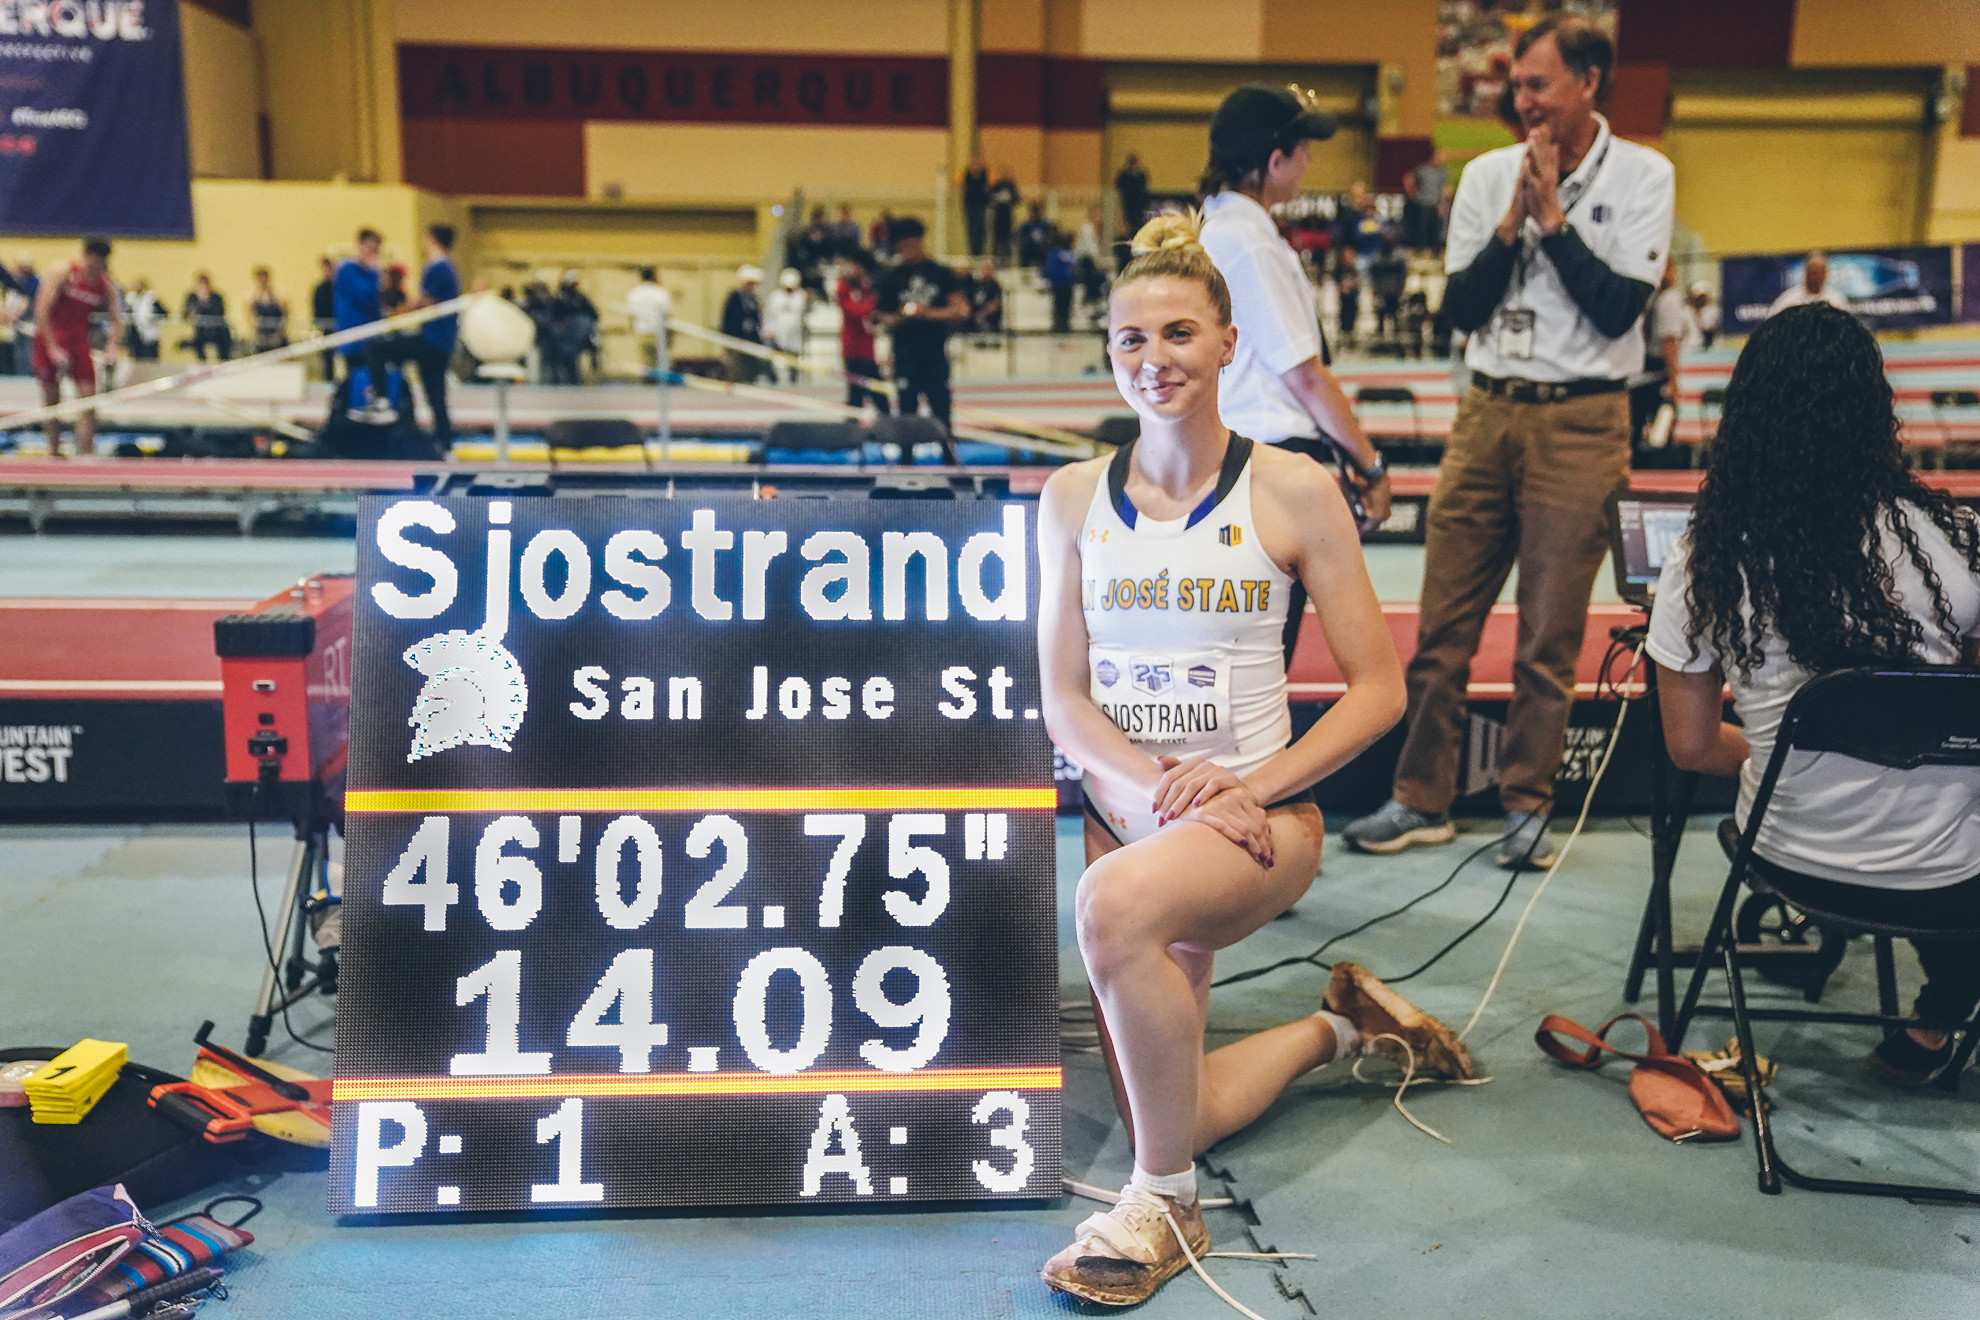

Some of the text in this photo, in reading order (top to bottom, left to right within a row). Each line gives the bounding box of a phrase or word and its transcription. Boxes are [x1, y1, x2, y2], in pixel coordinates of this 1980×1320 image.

[437, 60, 914, 115] ALBUQUERQUE
[371, 500, 1027, 643] Sjostrand
[1101, 568, 1170, 612] JOSÉ
[1177, 577, 1271, 613] STATE
[570, 665, 701, 720] San
[746, 665, 894, 720] Jose
[938, 665, 1041, 720] St.
[0, 746, 74, 783] EST
[383, 814, 1008, 931] 46'02.75"
[449, 946, 951, 1077] 14.09
[355, 1090, 1035, 1207] P: 1 A: 3
